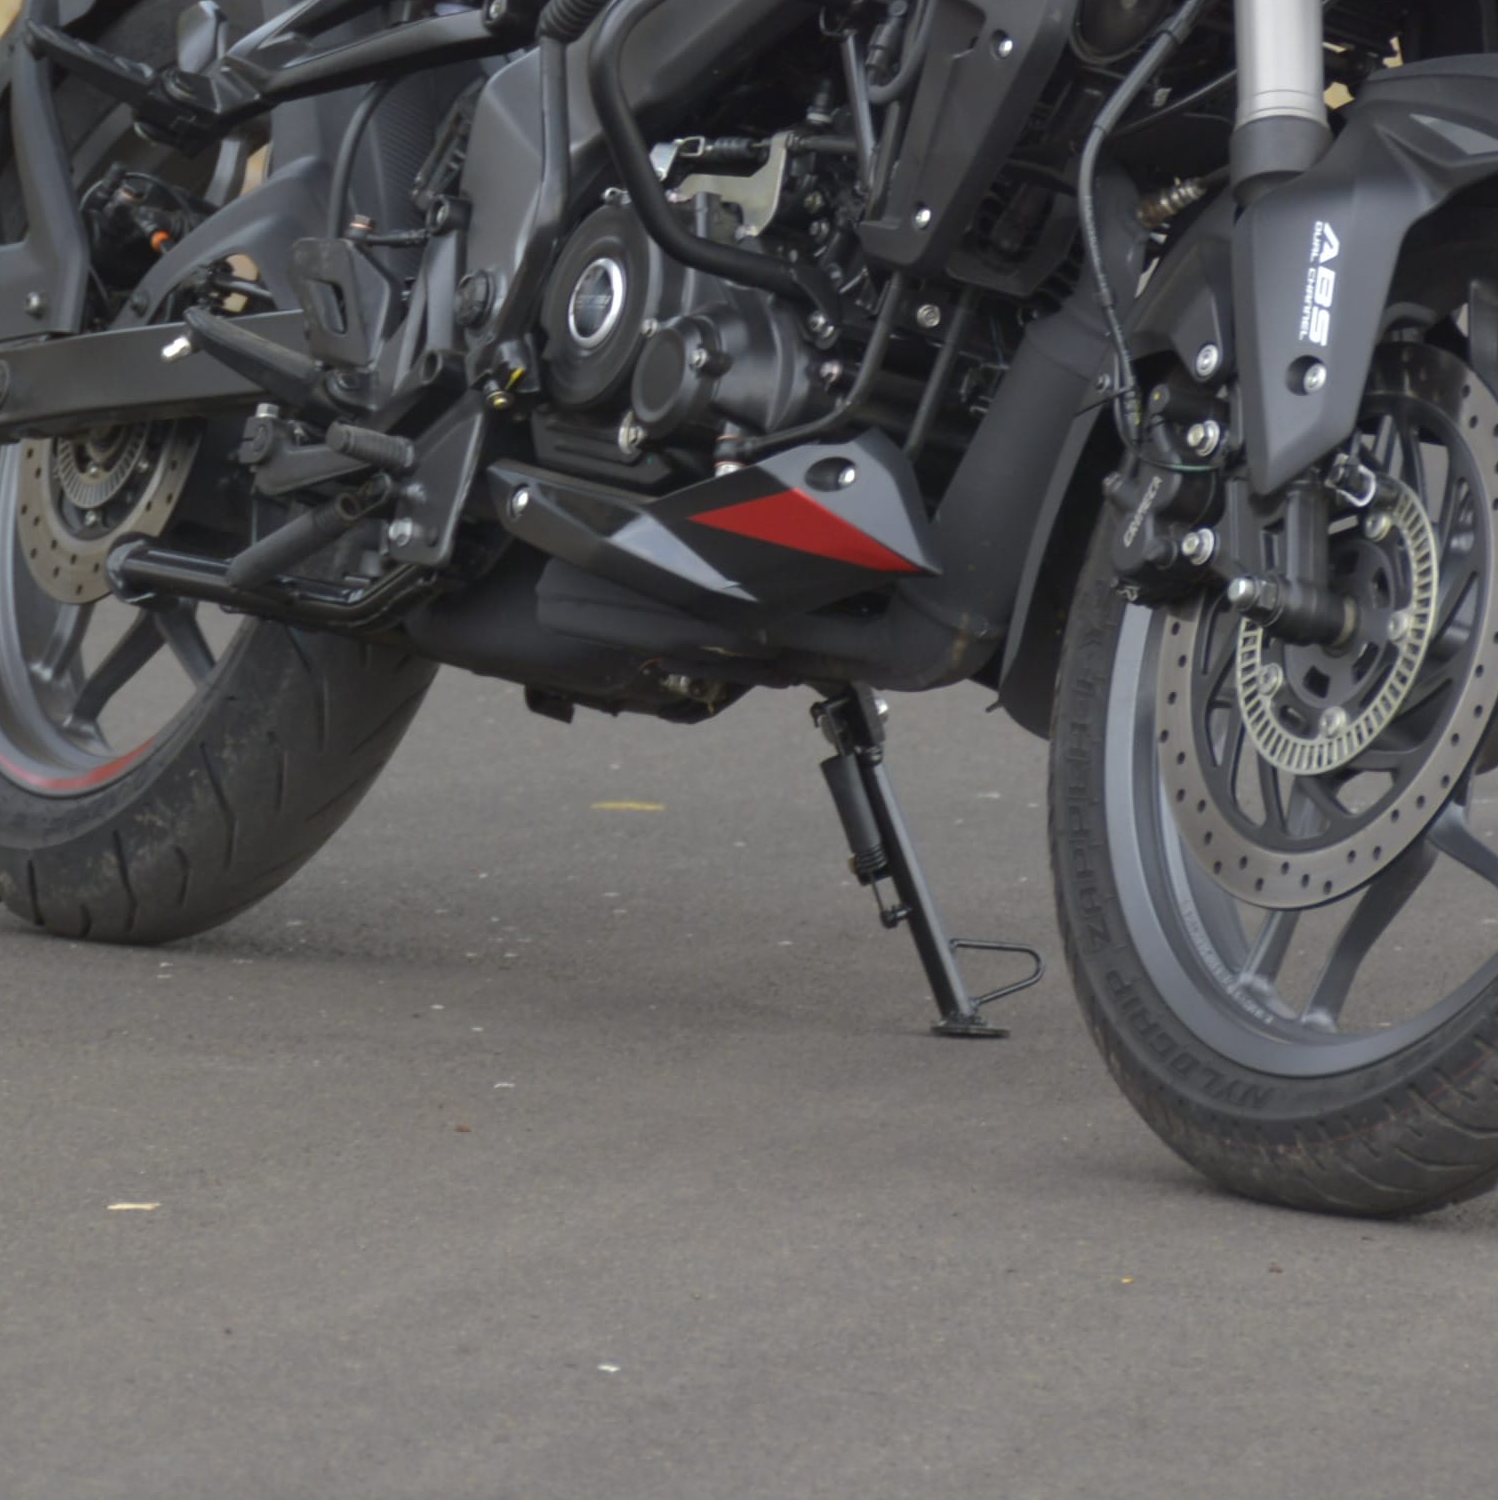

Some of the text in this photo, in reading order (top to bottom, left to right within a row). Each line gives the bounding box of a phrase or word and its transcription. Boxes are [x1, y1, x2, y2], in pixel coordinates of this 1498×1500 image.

[1298, 220, 1324, 341] DUAL CHANNEL
[1309, 221, 1340, 347] ABS
[1104, 968, 1271, 1113] NYLOGRIP
